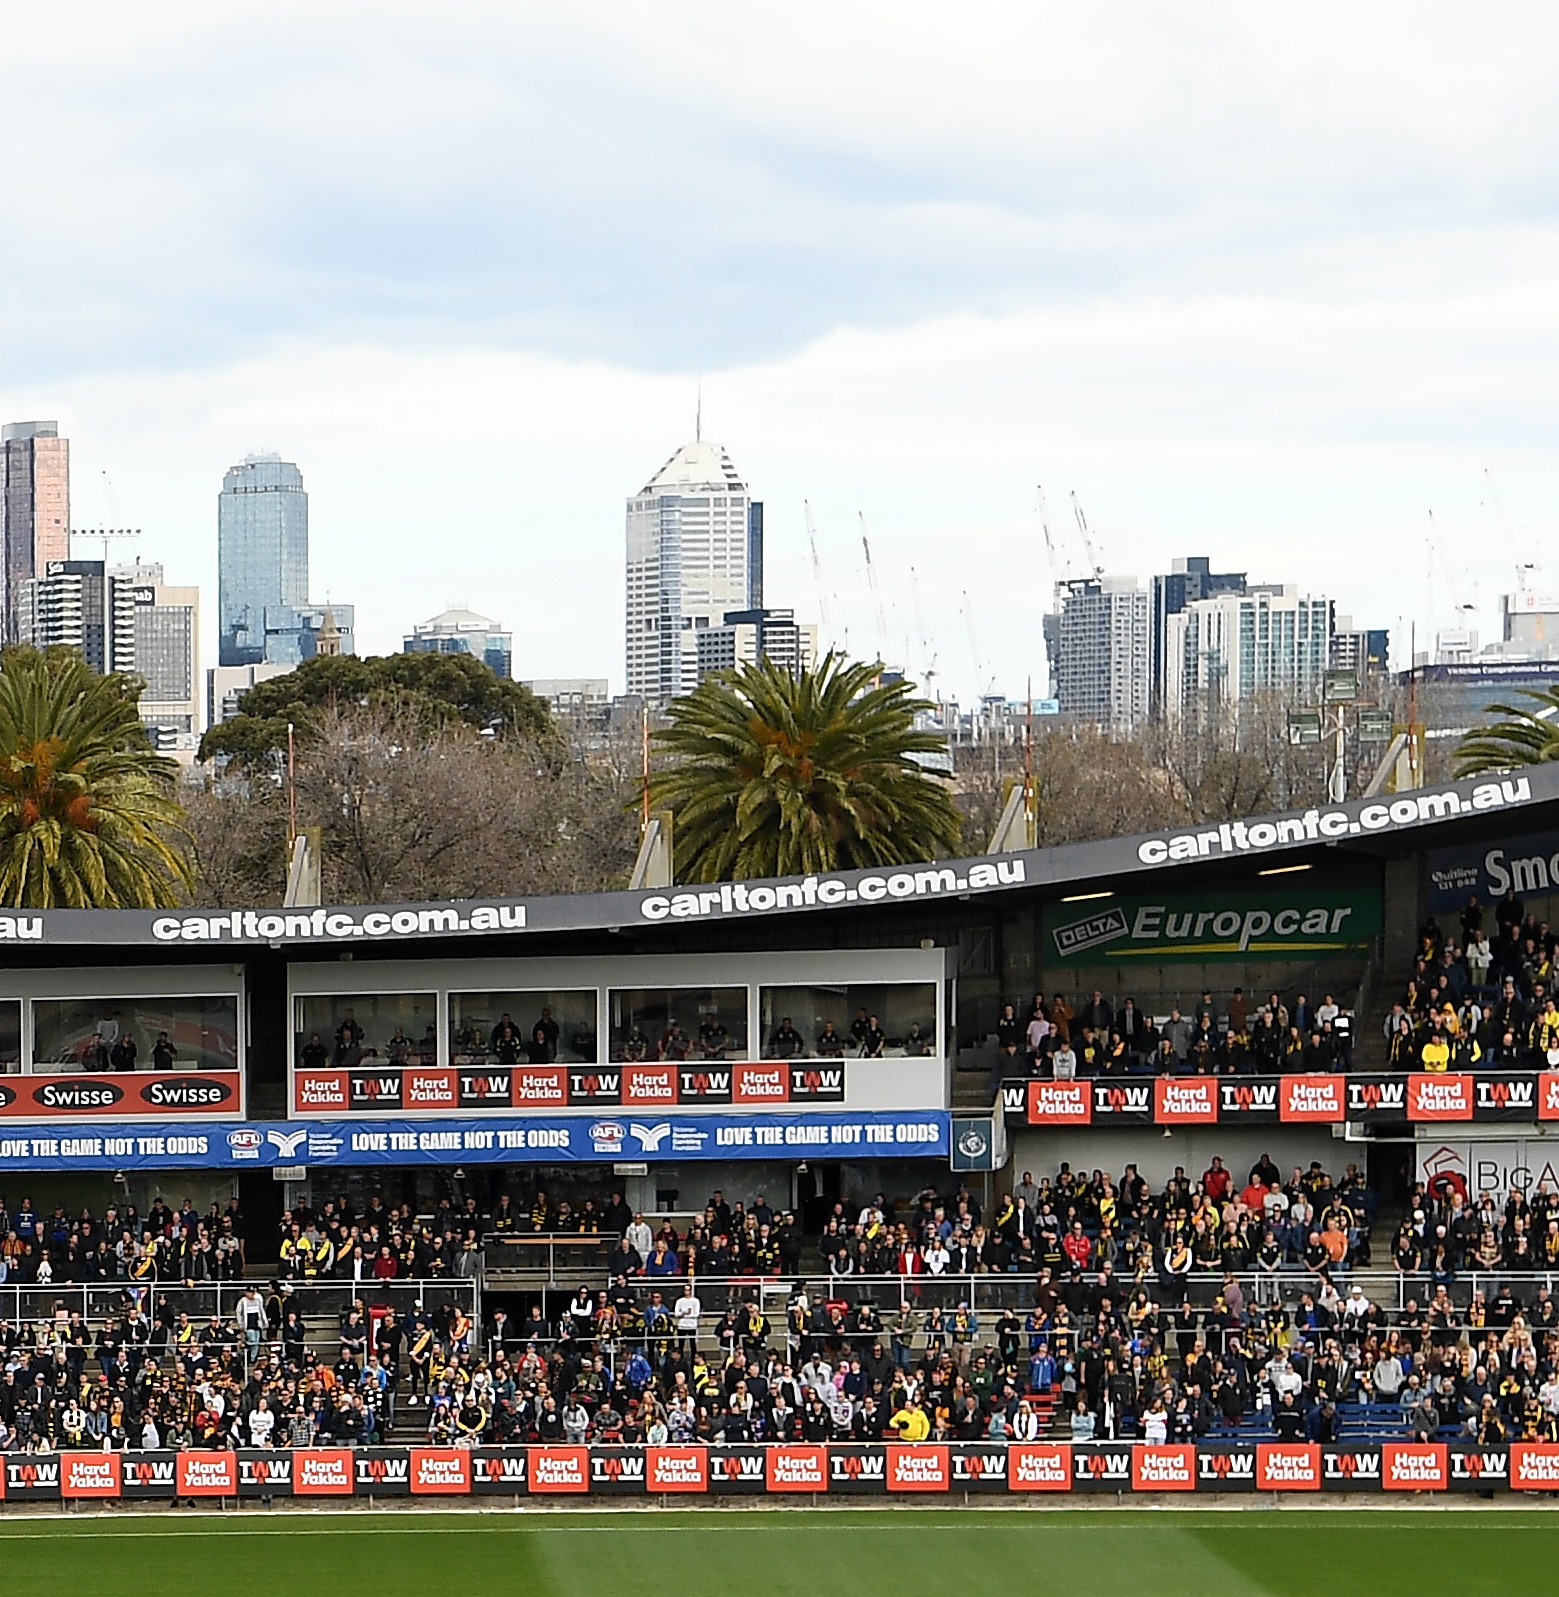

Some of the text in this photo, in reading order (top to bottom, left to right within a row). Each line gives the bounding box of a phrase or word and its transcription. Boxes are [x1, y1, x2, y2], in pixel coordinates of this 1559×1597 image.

[1138, 776, 1531, 864] carltonfc.com.au
[641, 859, 1026, 920] carltonfc.com.au
[153, 903, 526, 940] carltonfc.com.au
[1058, 916, 1121, 946] DELTA
[1132, 906, 1351, 952] Europcar
[304, 1079, 340, 1091] Hard
[413, 1077, 449, 1089] Hard
[632, 1073, 668, 1086] Hard
[43, 1086, 113, 1105] Swisse
[151, 1084, 221, 1104] Swisse
[301, 1090, 344, 1103] Yakka
[409, 1087, 453, 1101] Yakka
[629, 1084, 672, 1098] Yakka
[1040, 1087, 1080, 1101] Hard
[1293, 1084, 1333, 1098] Hard
[1420, 1083, 1461, 1097] Hard
[1037, 1099, 1085, 1114] Yakka
[1289, 1097, 1338, 1112] Yakka
[1416, 1096, 1466, 1110] Yakka
[593, 1126, 623, 1138] AFL
[31, 1139, 58, 1156] THE
[60, 1139, 102, 1155] GAME
[104, 1138, 132, 1154] NOT
[137, 1138, 164, 1154] THE
[167, 1137, 207, 1154] ODDS
[230, 1134, 260, 1145] AFL
[352, 1133, 387, 1151] LOVE
[390, 1132, 418, 1150] THE
[419, 1132, 462, 1150] GAME
[464, 1131, 494, 1149] NOT
[497, 1130, 525, 1148] THE
[527, 1130, 570, 1148] ODDS
[304, 1459, 342, 1473] Hard
[658, 1456, 696, 1470] Hard
[1020, 1454, 1060, 1468] Hard
[1395, 1453, 1436, 1467] Hard
[301, 1472, 347, 1486] Yakka
[654, 1469, 701, 1482] Yakka
[1017, 1466, 1065, 1481] Yakka
[1391, 1466, 1440, 1481] Yakka
